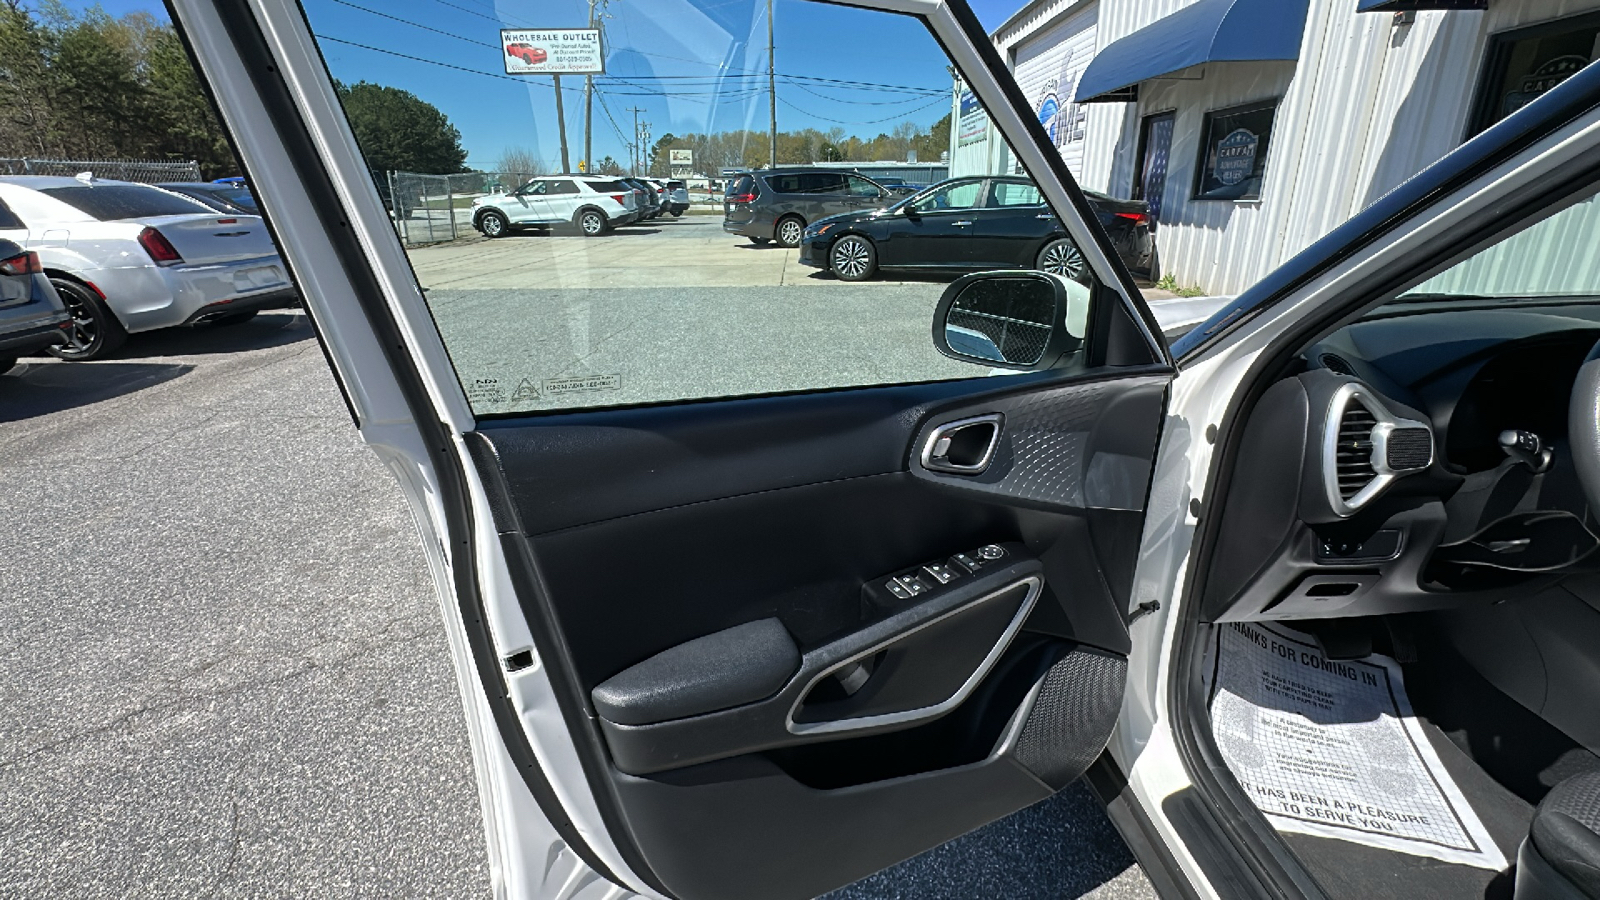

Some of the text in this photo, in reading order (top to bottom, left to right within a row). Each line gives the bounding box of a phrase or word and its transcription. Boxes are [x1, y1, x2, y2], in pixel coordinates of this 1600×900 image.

[504, 33, 597, 42] WHOLESALE OUTLET
[1220, 146, 1254, 158] CARFAX
[1271, 640, 1297, 663] FOR
[1301, 652, 1358, 681] COMING
[1361, 671, 1378, 688] IN
[1262, 676, 1278, 687] YOUR
[1256, 783, 1286, 799] HAS
[1289, 791, 1330, 808] BEEN
[1333, 799, 1345, 811] A
[1349, 801, 1432, 826] PLEASURE
[1279, 800, 1394, 832] TO SERVE YOU
